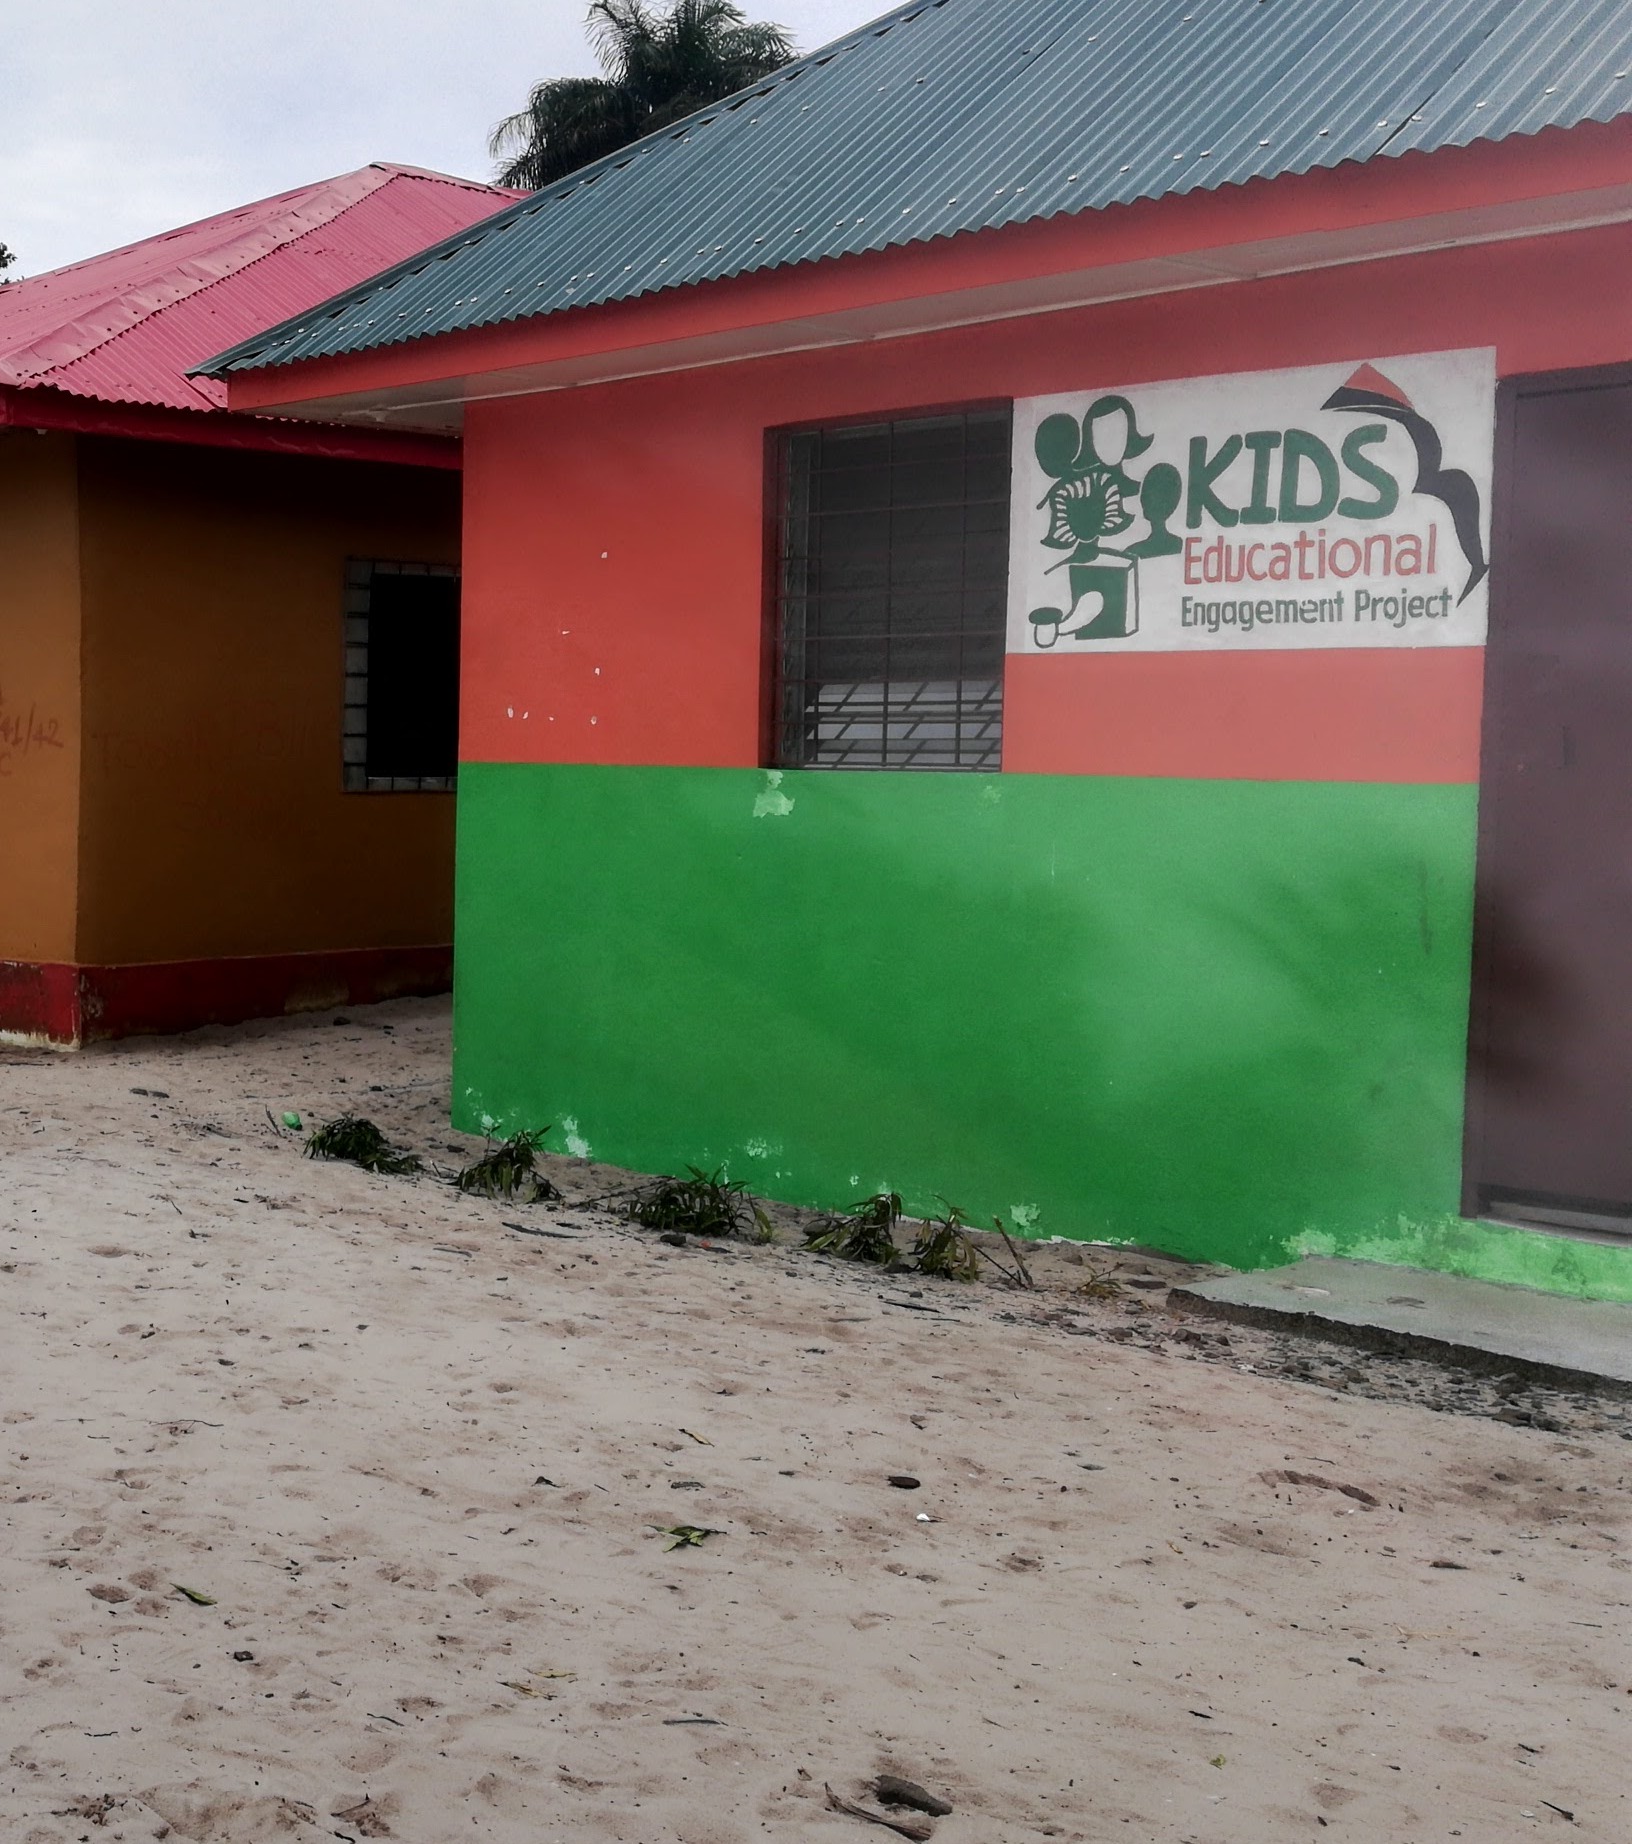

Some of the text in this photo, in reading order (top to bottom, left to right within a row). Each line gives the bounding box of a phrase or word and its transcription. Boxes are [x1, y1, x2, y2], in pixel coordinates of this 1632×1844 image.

[1186, 425, 1399, 529] KIDS
[1184, 524, 1437, 585] Educational
[1181, 587, 1452, 633] Engagement Project
